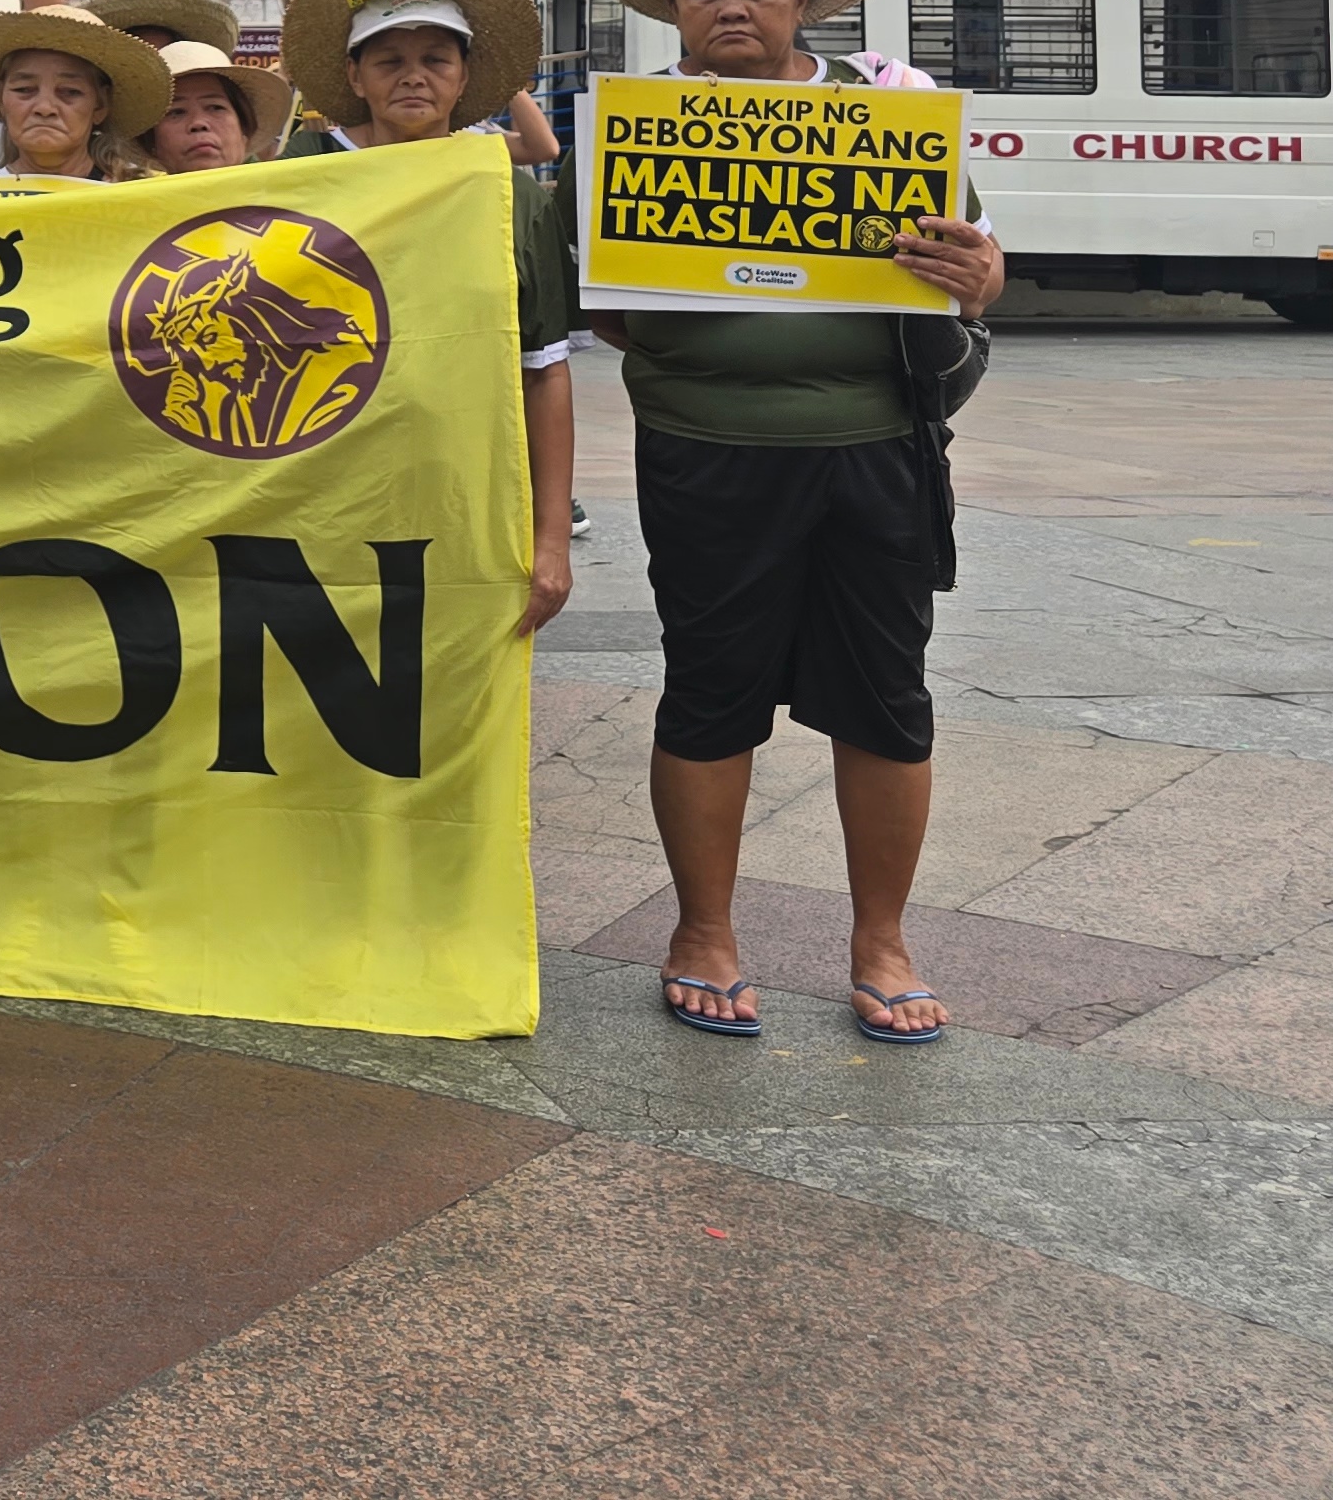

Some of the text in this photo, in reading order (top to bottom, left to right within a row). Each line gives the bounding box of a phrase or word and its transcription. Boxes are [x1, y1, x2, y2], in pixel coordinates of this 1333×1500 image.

[680, 94, 871, 125] KALAKIP NG
[606, 115, 835, 156] DEBOSYON
[847, 128, 948, 162] ANG
[1072, 133, 1304, 163] CHURCH
[610, 155, 938, 214] MALINIS NA
